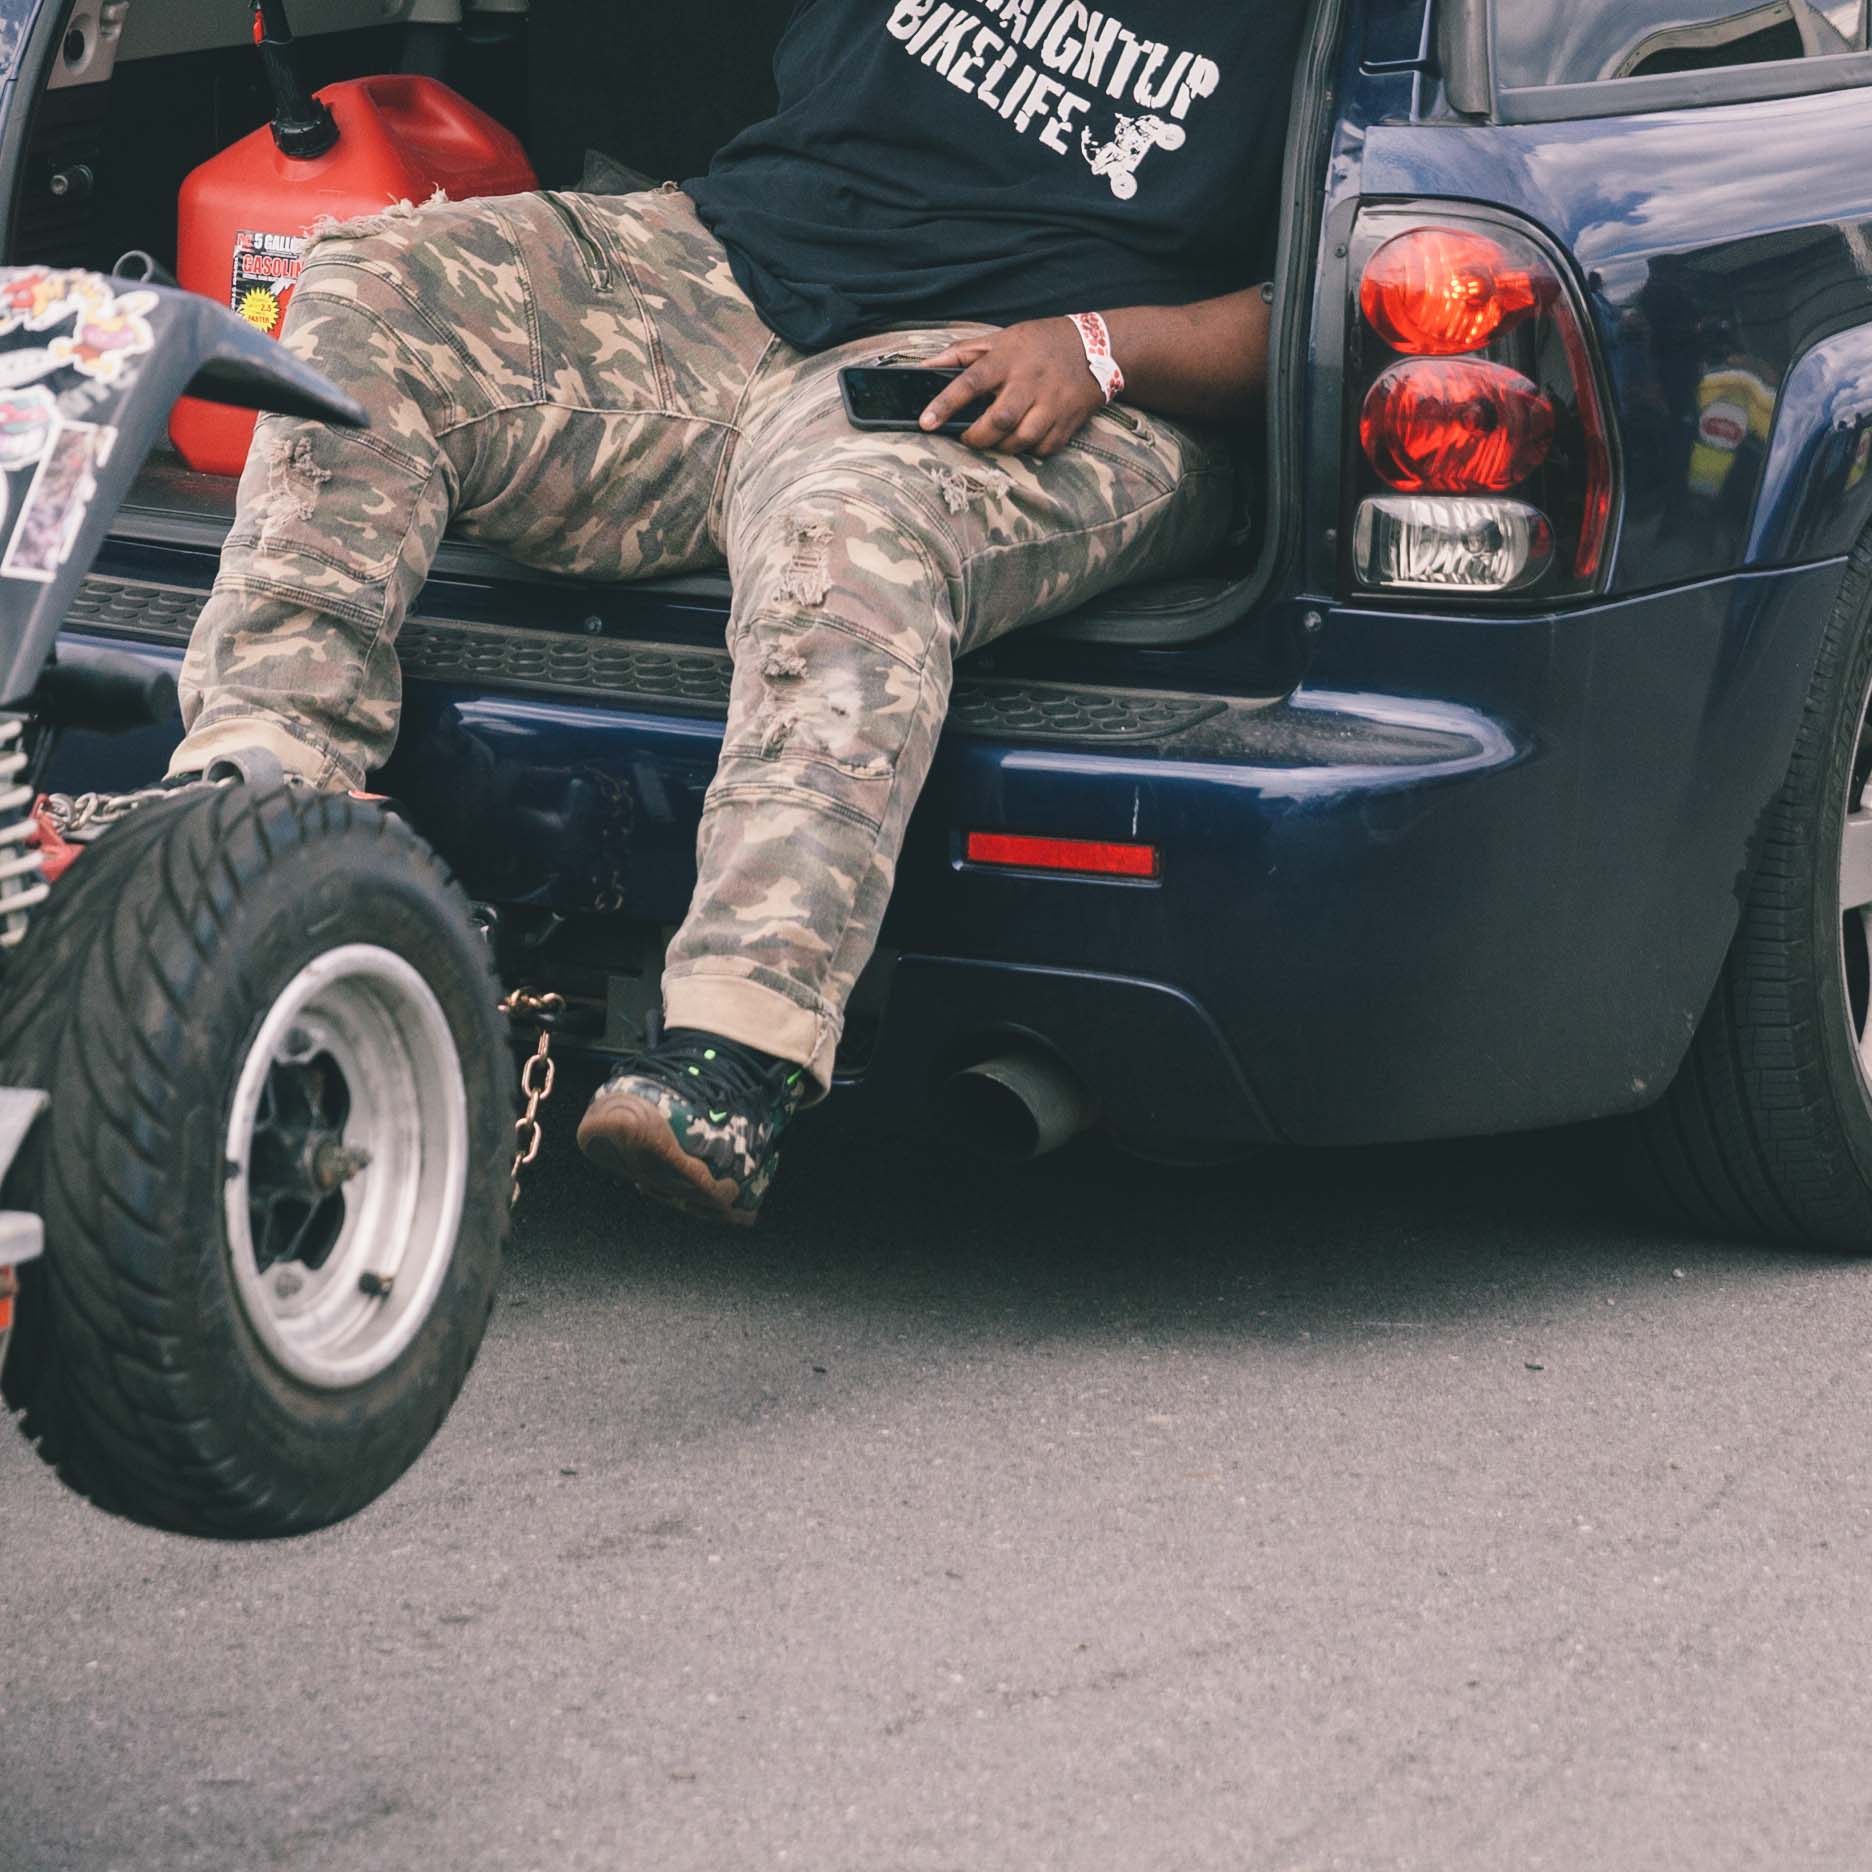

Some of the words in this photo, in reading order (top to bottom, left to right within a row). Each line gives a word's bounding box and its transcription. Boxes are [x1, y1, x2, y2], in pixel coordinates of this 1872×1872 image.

[254, 233, 264, 249] 5
[265, 234, 296, 251] GALL
[242, 254, 303, 278] GASOLIN
